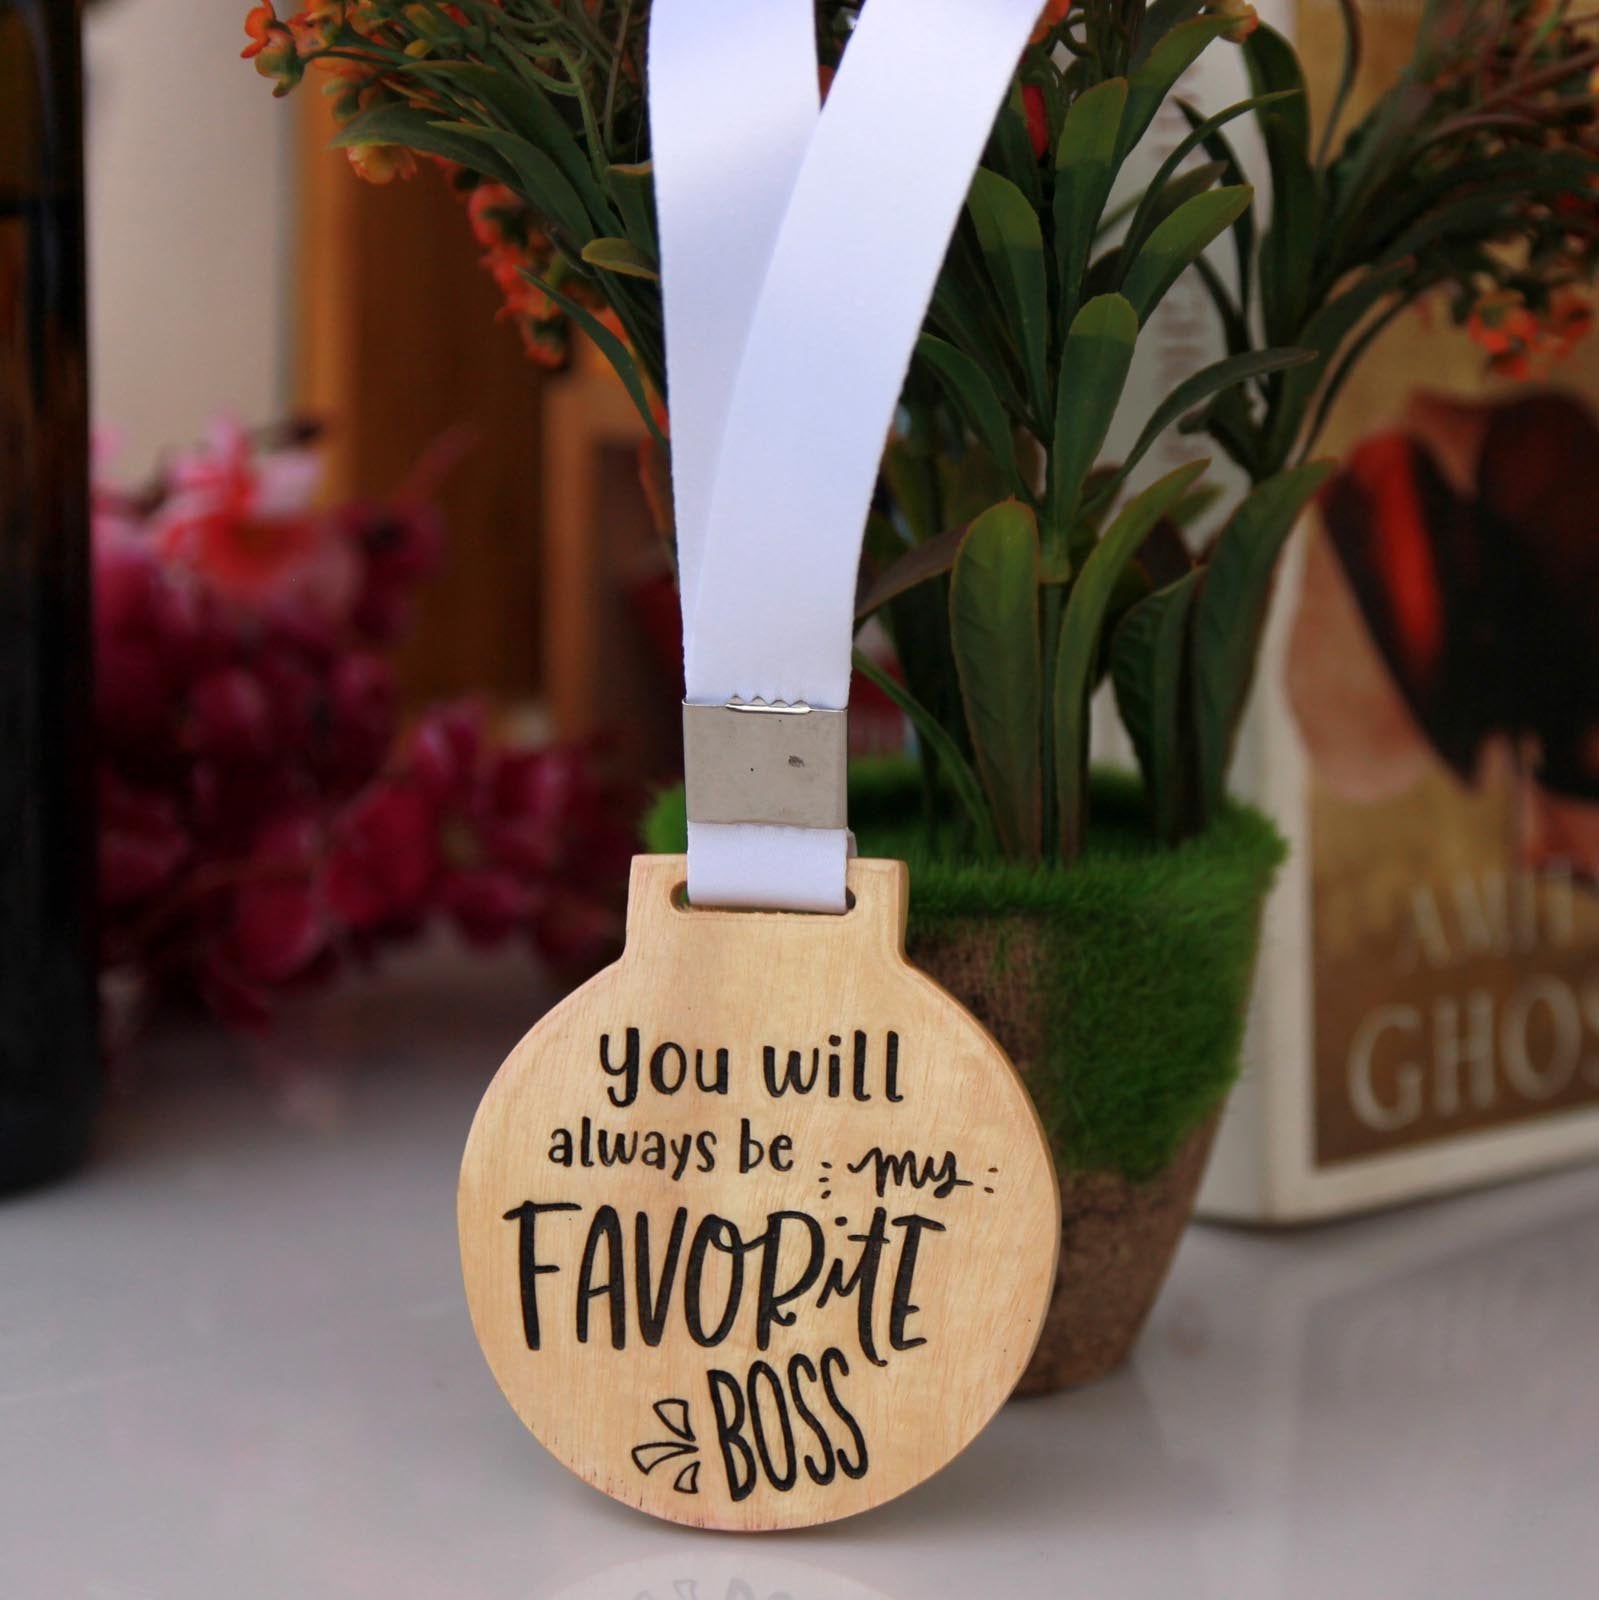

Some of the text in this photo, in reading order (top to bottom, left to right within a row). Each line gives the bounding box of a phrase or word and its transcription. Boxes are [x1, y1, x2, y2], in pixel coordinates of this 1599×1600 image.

[762, 1029, 904, 1102] will
[547, 1116, 974, 1198] always be my
[706, 1346, 869, 1502] BOSS
